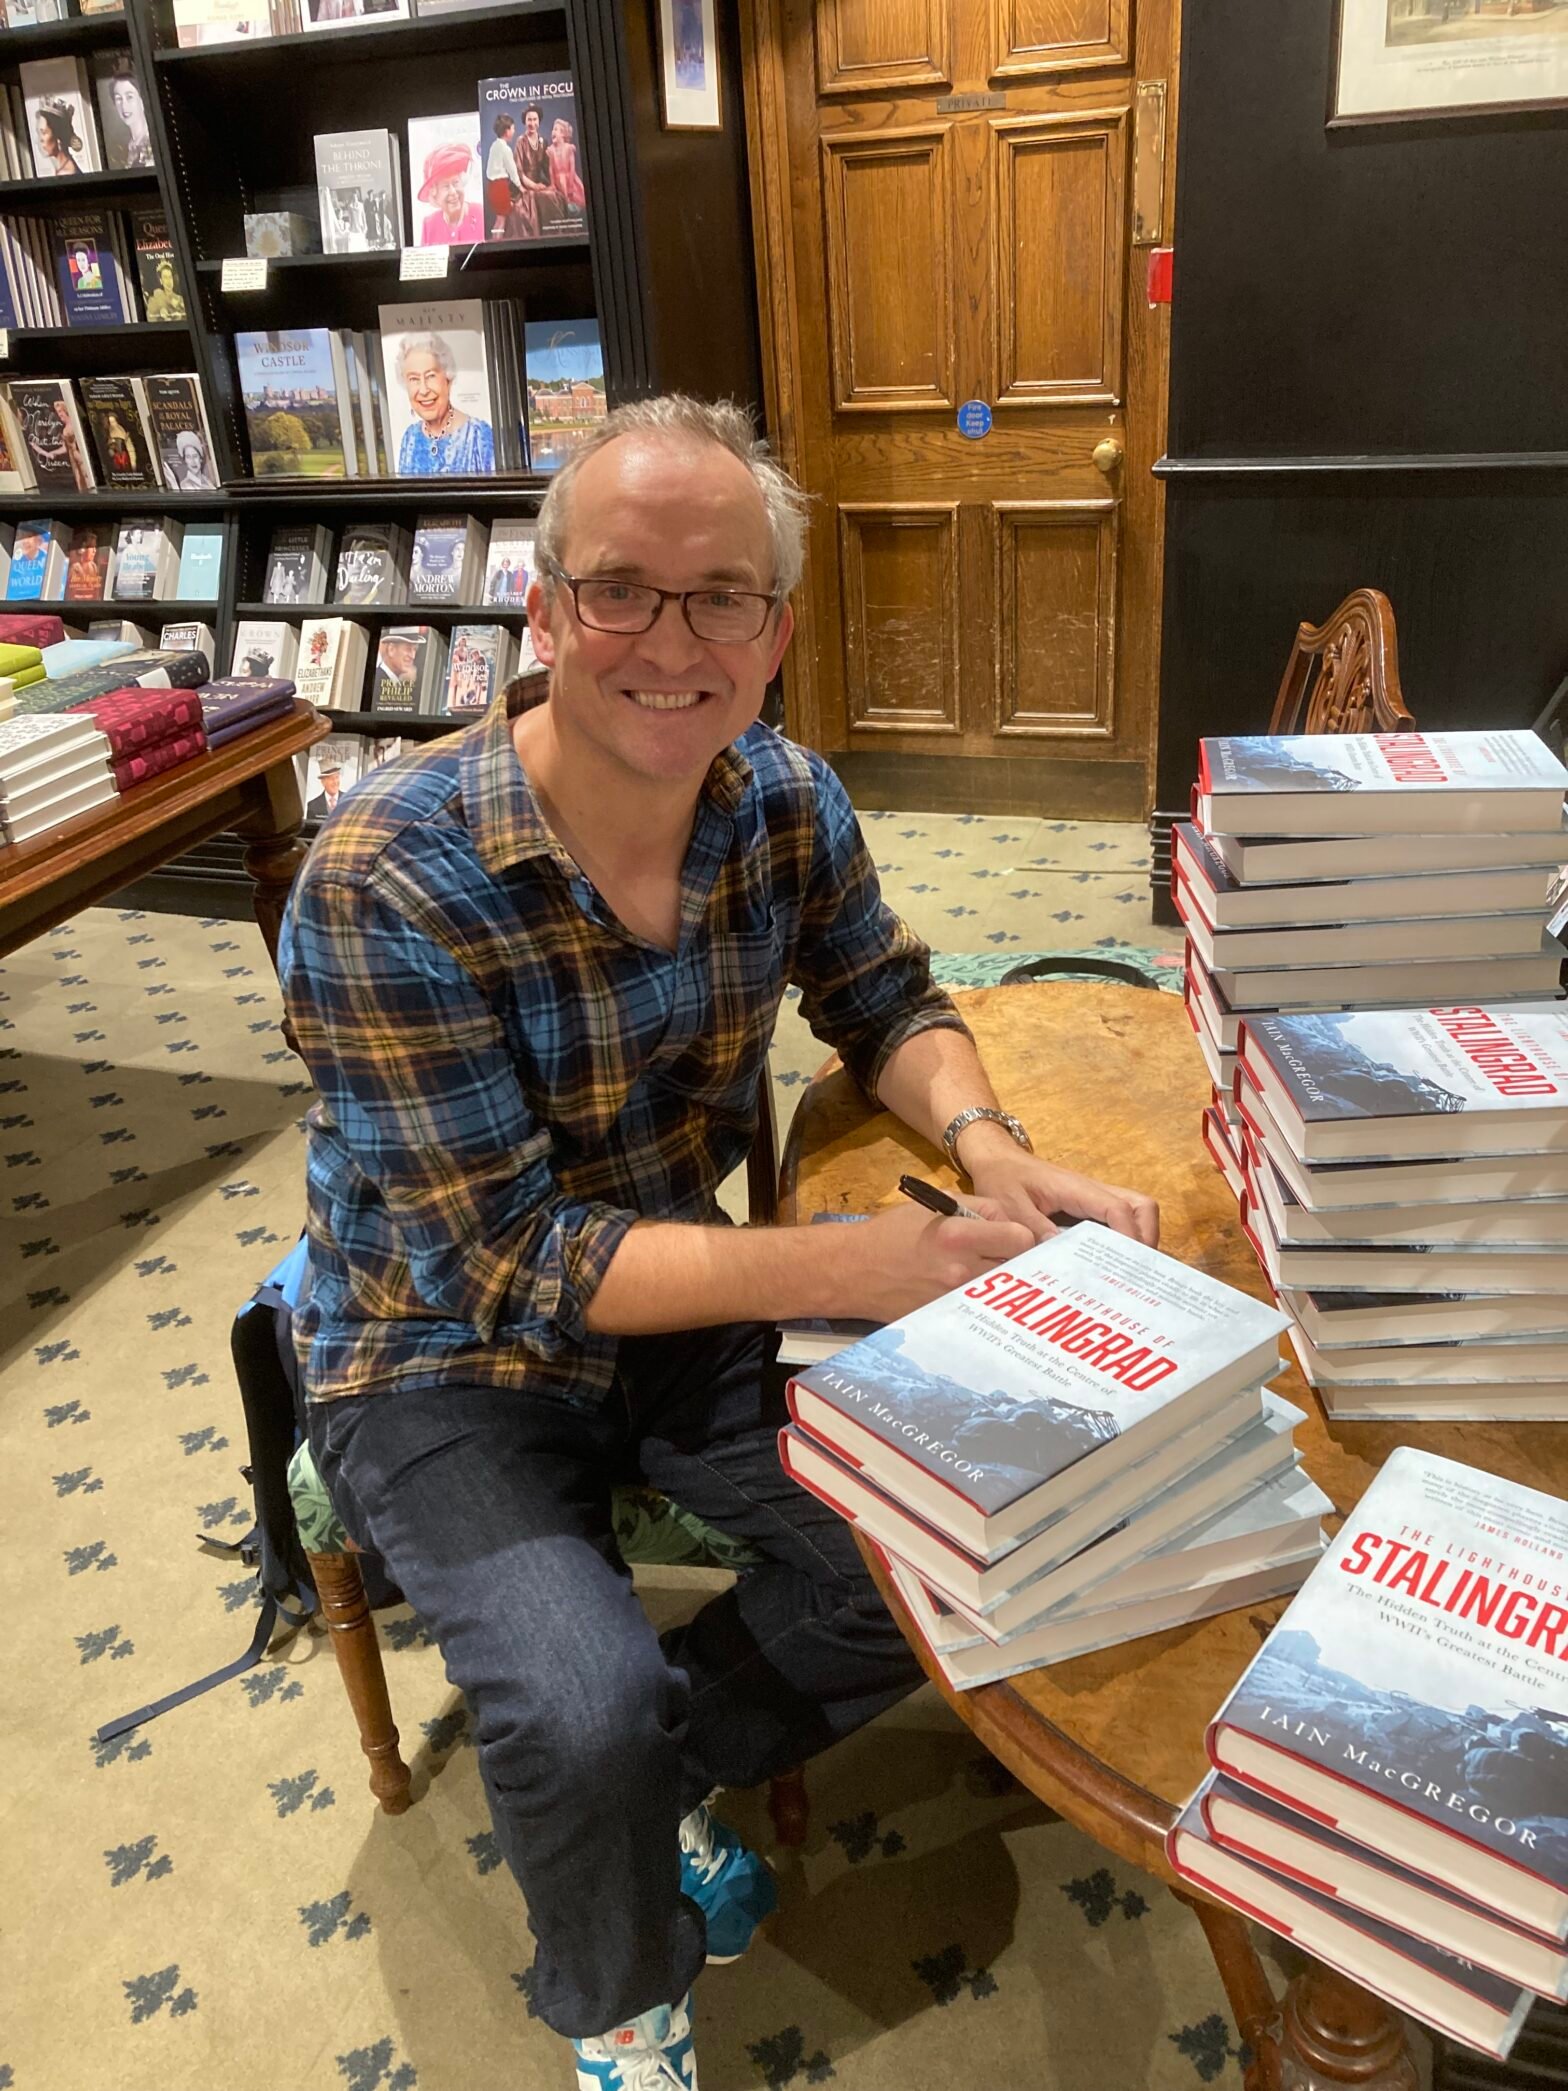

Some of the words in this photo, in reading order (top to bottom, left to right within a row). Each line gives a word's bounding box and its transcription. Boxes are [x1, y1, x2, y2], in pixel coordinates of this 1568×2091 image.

[486, 86, 527, 101] CROWN
[529, 85, 540, 97] IN
[947, 96, 992, 109] PRIVATE
[333, 149, 370, 161] BEHIND
[321, 163, 341, 174] THE
[343, 159, 384, 172] THRONE
[396, 313, 466, 326] MAJESTY
[253, 341, 311, 354] WINDSOR
[261, 355, 306, 368] CASTLE
[152, 401, 193, 410] SCANDALS
[165, 412, 191, 420] ROYAL
[160, 422, 194, 430] PALACES
[13, 560, 44, 573] QUEEN
[11, 576, 42, 588] WORLD
[415, 574, 455, 584] ANDREW
[413, 583, 455, 593] MORTON
[163, 630, 196, 641] CHARLES
[381, 679, 416, 688] PRINCE
[381, 687, 413, 695] PHILIP
[1374, 734, 1449, 782] STALINGRAD
[1429, 1007, 1558, 1096] STALINGRAD
[1262, 1021, 1280, 1043] IAIN
[1280, 1044, 1325, 1103] MacGREGOR
[1031, 1270, 1059, 1287] THE
[1060, 1286, 1151, 1335] LIGHTHOUSE
[1153, 1335, 1175, 1349] OF
[964, 1271, 1178, 1391] STALINGRAD
[957, 1303, 976, 1319] The
[975, 1311, 1009, 1335] Hidden
[1010, 1332, 1037, 1351] Truth
[1036, 1347, 1050, 1359] at
[1050, 1354, 1065, 1369] the
[1066, 1364, 1101, 1389] Centre
[1100, 1384, 1118, 1397] of
[968, 1323, 1002, 1347] WWII's
[1003, 1343, 1042, 1371] Greatest
[1042, 1366, 1072, 1388] Battle
[822, 1372, 868, 1403] IAIN
[868, 1402, 984, 1483] MacGREGOR
[1474, 1520, 1510, 1540] JAMES
[1514, 1535, 1565, 1561] HOLLAND
[1400, 1525, 1435, 1547] THE
[1446, 1543, 1568, 1602] LIGHTHOUS
[1347, 1583, 1373, 1600] The
[1377, 1592, 1428, 1623] Hidden
[1433, 1616, 1474, 1643] Truth
[1477, 1639, 1492, 1651] at
[1496, 1645, 1520, 1662] the
[1380, 1611, 1432, 1640] WWII's
[1437, 1635, 1496, 1669] Greatest
[1502, 1663, 1547, 1690] Battle
[1260, 1705, 1332, 1748] IAIN
[1343, 1744, 1540, 1850] MacGREGOR
